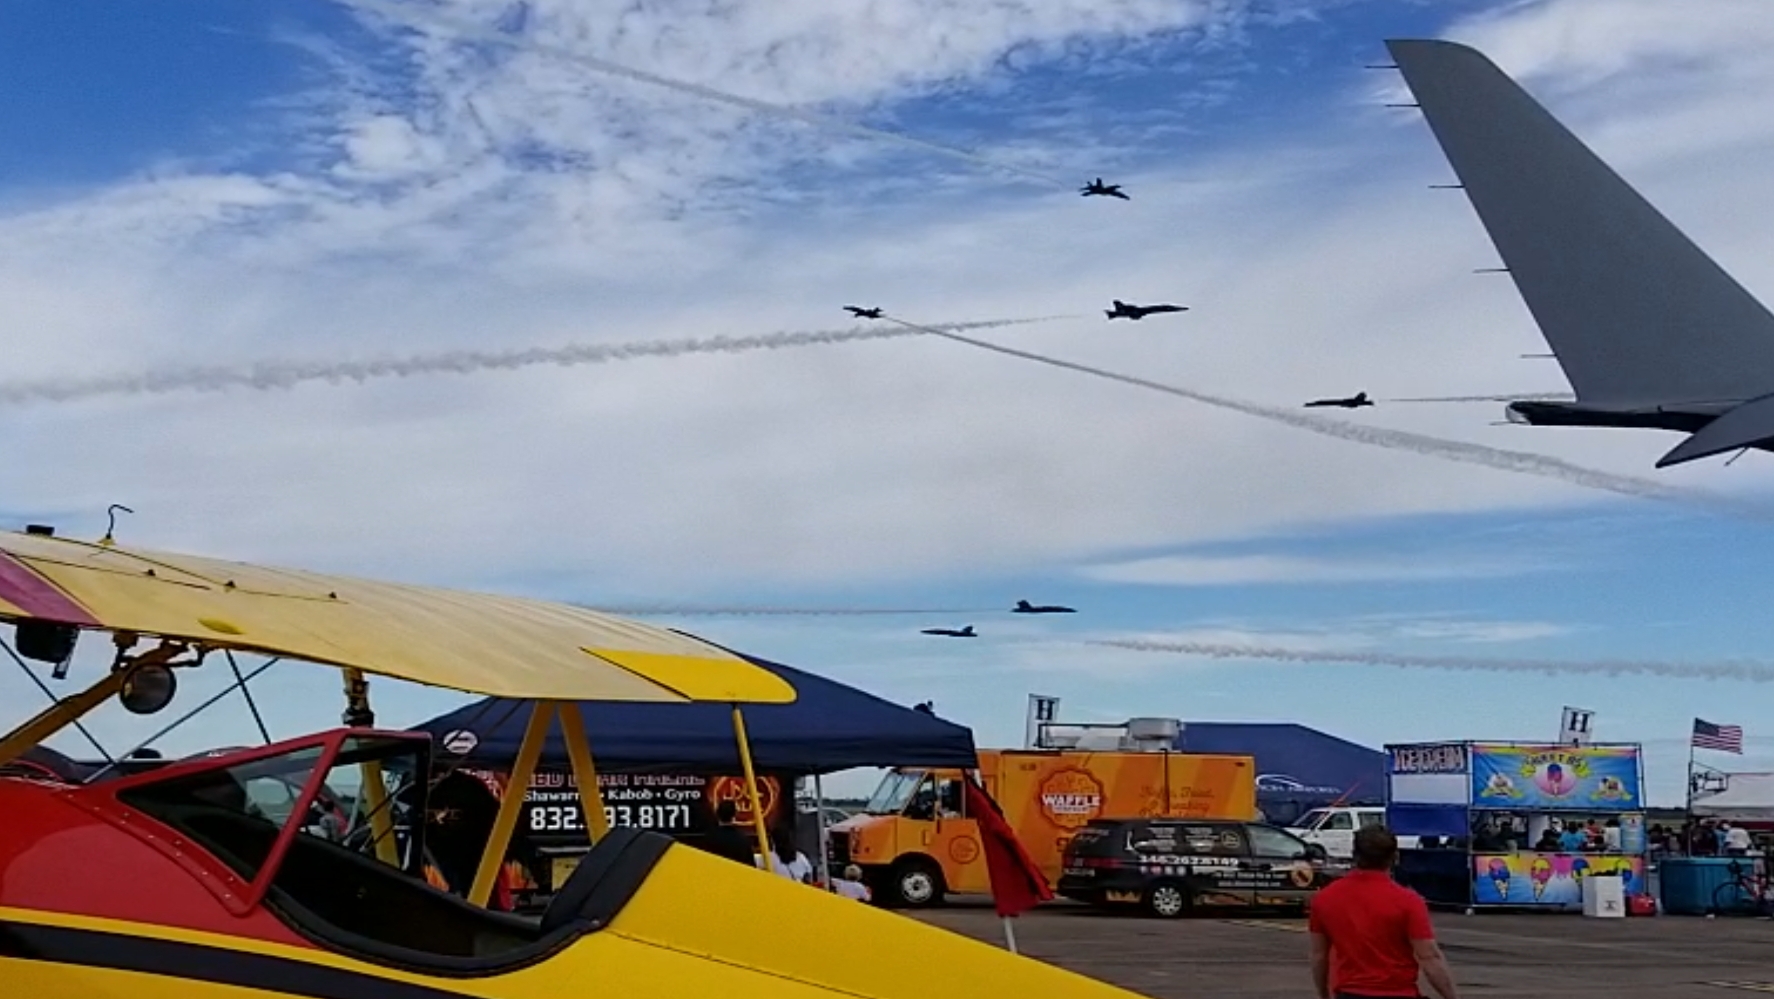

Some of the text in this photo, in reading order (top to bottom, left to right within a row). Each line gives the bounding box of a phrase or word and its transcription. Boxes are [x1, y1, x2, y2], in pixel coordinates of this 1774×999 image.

[1036, 699, 1055, 720] H
[1568, 711, 1590, 732] H
[608, 788, 653, 800] Kabob
[664, 789, 701, 802] Gyro
[1042, 793, 1101, 806] WAFFLE
[530, 805, 690, 830] 832.93.8171
